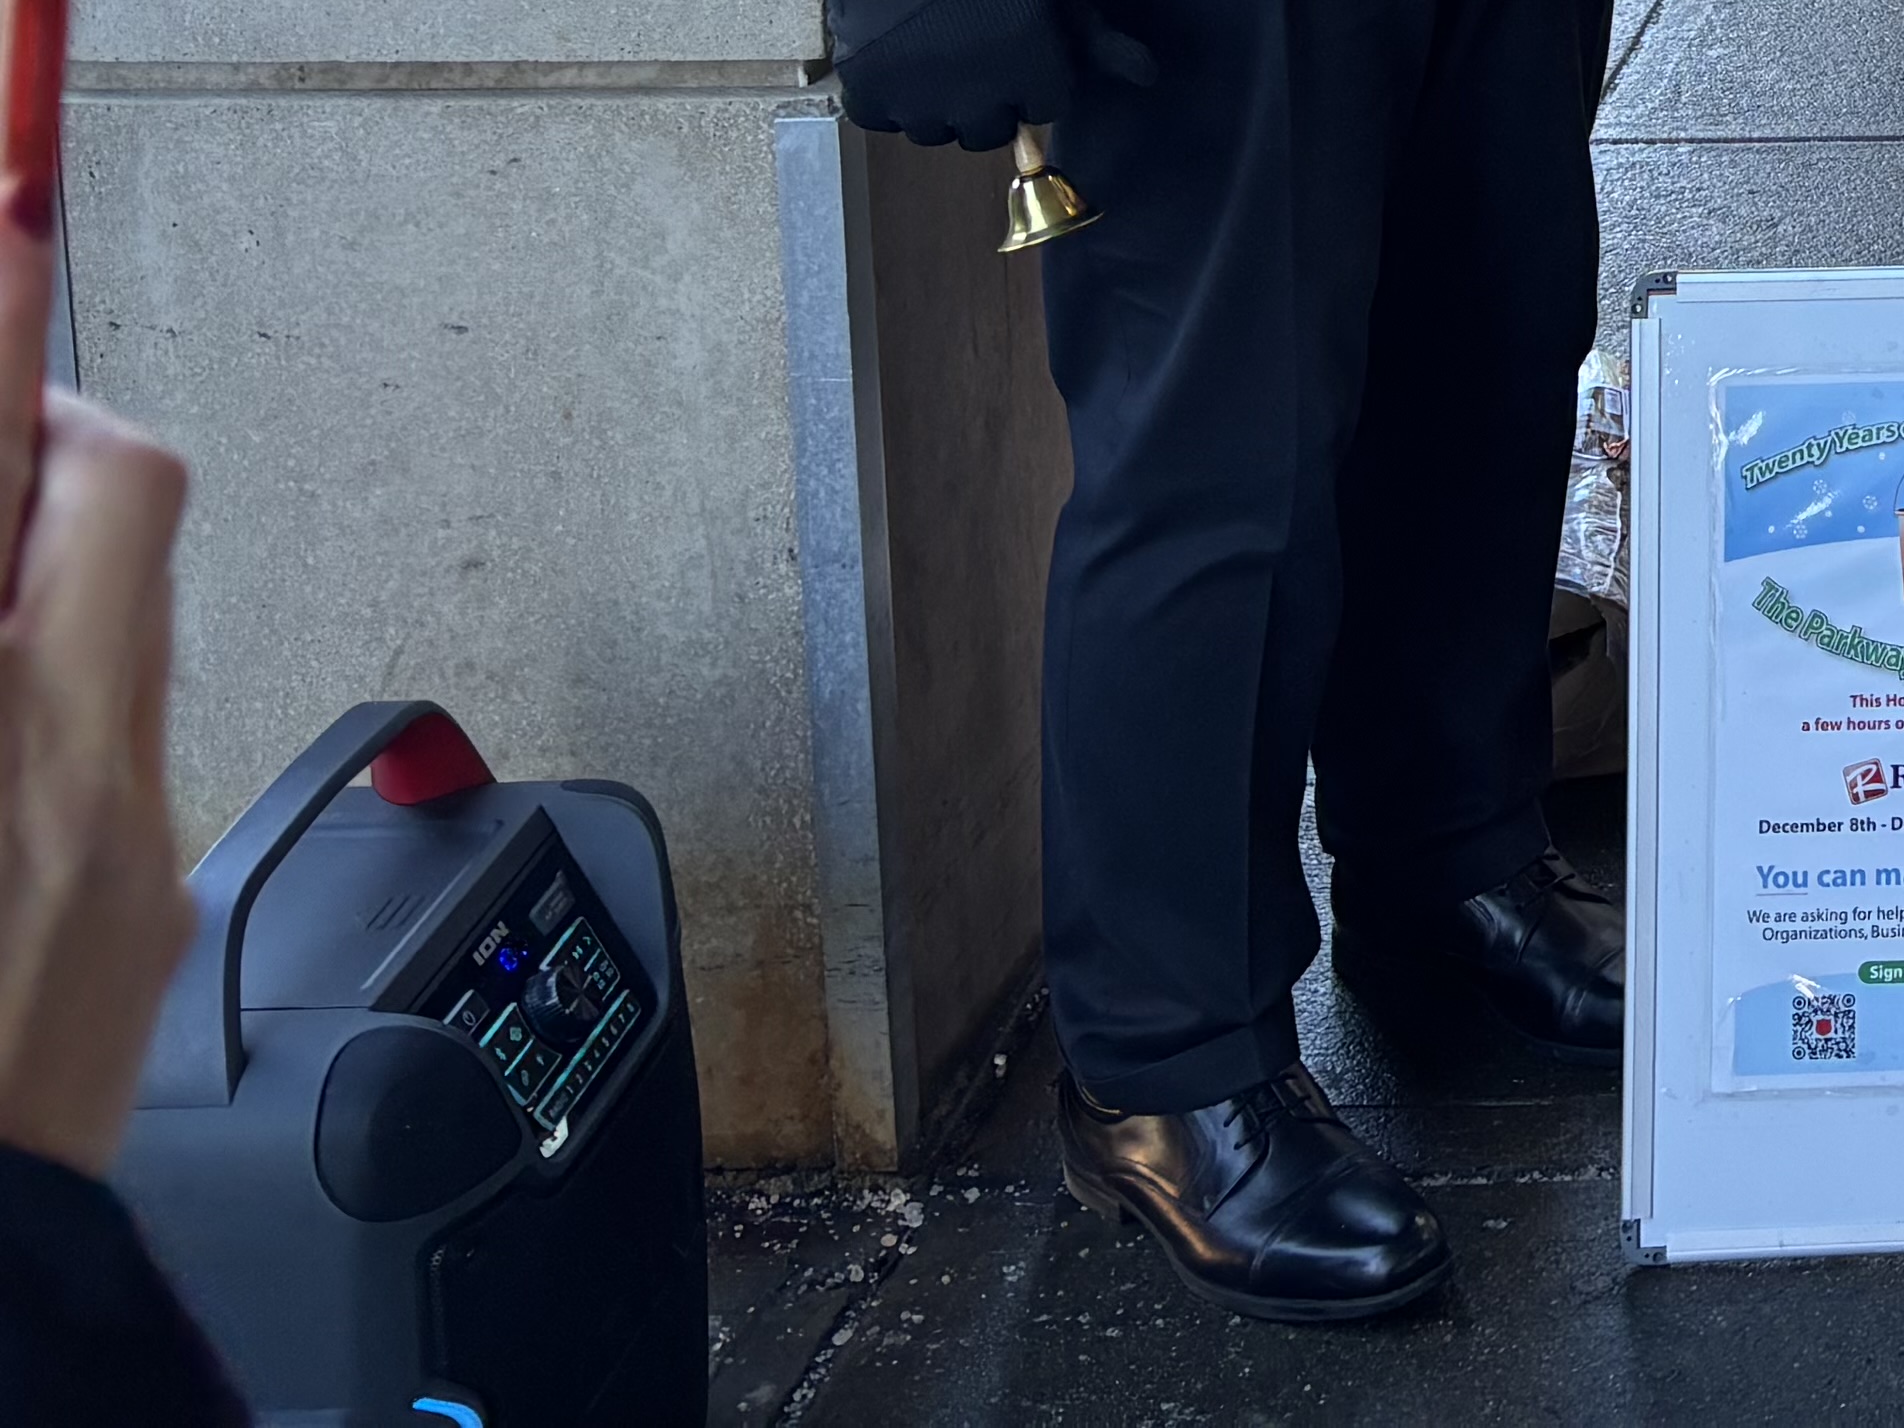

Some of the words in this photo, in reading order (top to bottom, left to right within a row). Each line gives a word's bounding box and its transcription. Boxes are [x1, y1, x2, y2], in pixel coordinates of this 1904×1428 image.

[1741, 435, 1834, 491] Twenty
[1830, 420, 1899, 455] Years
[1751, 577, 1803, 633] The
[1849, 694, 1882, 709] This
[1801, 720, 1811, 732] a
[1814, 716, 1842, 732] few
[1846, 716, 1891, 732] hours
[1759, 818, 1844, 834] December
[1849, 817, 1877, 832] 8th
[1756, 865, 1809, 890] You
[1816, 868, 1866, 888] can
[1747, 909, 1771, 924] We
[1774, 912, 1797, 923] are
[1801, 908, 1848, 925] asking
[1852, 907, 1873, 921] for
[1762, 926, 1868, 944] Organizations,
[1870, 965, 1903, 981] Sign
